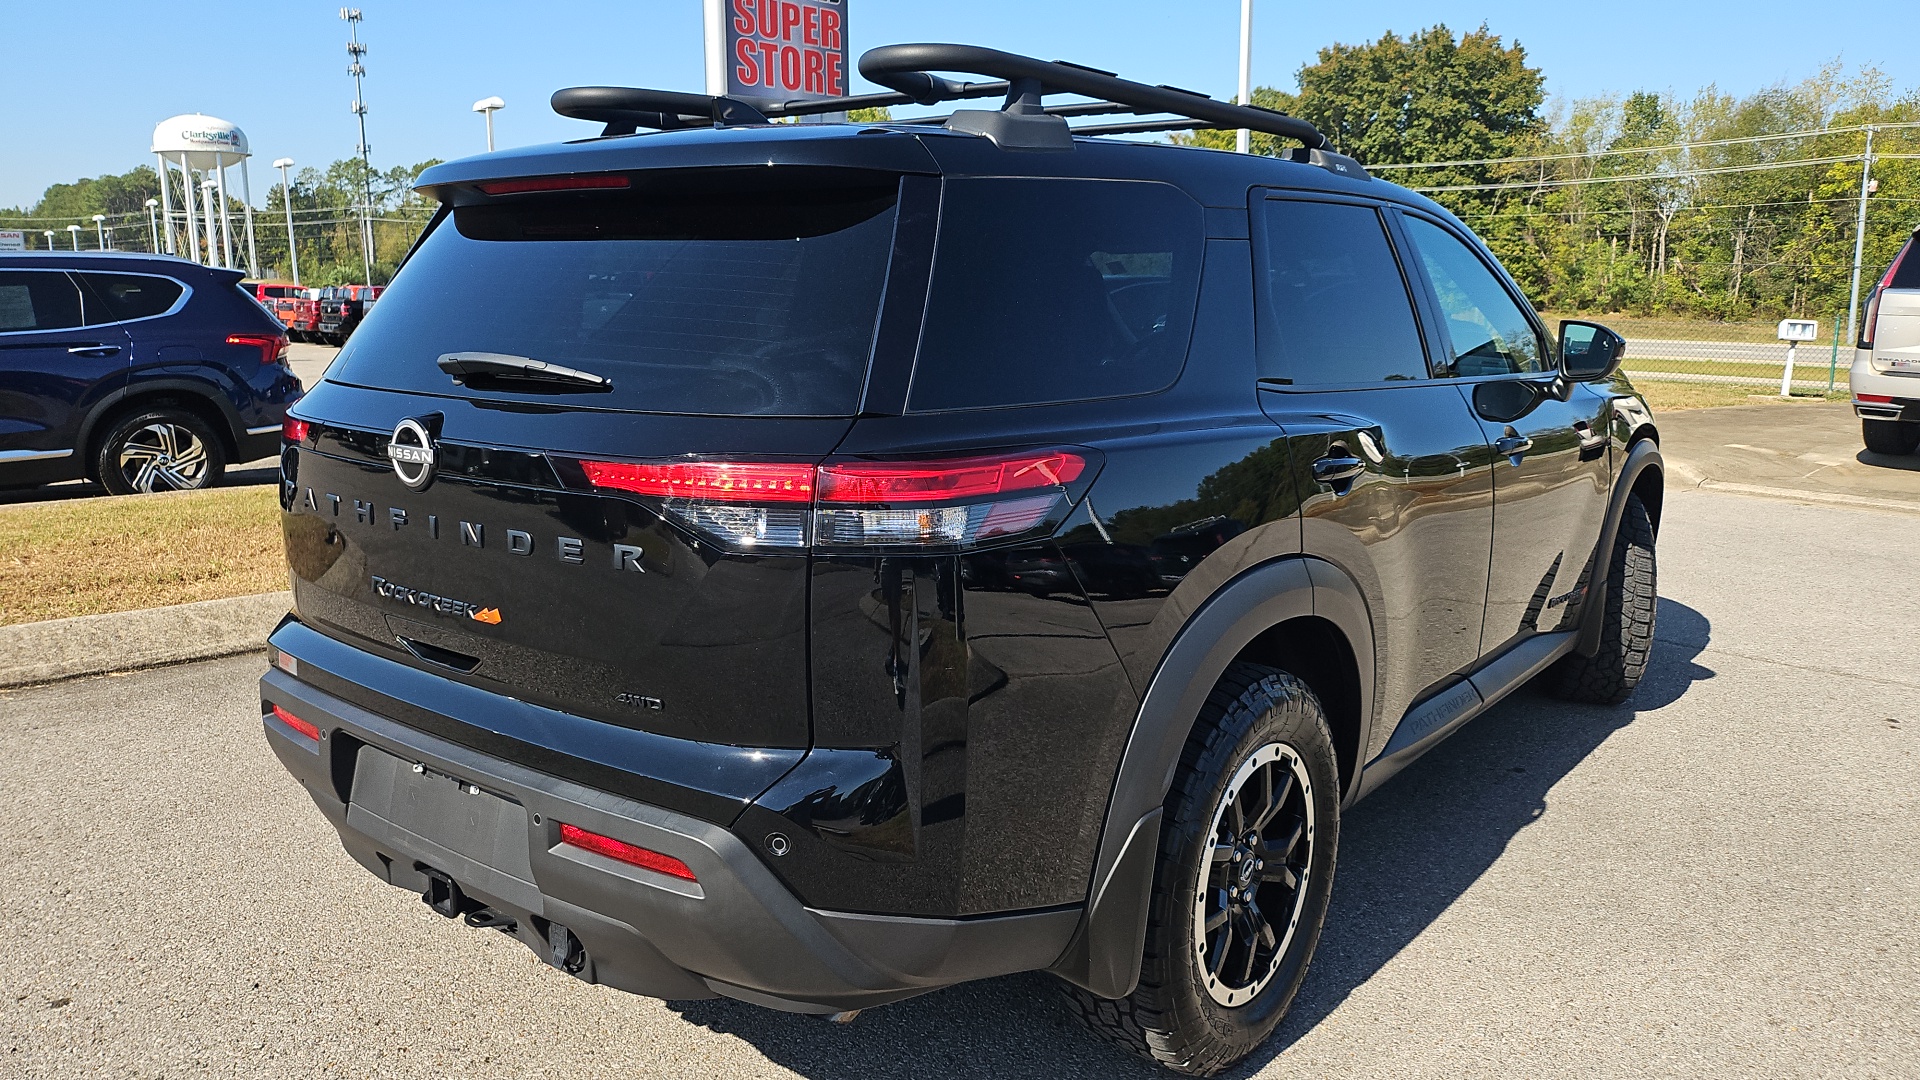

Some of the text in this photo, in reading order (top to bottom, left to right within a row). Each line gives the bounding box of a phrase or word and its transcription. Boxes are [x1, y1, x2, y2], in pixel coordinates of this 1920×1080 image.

[733, 0, 841, 50] SUPER
[736, 37, 842, 97] STORE
[182, 130, 231, 141] Clarksville
[388, 445, 432, 462] NISSAN
[284, 479, 646, 574] PATHFINDER
[371, 575, 479, 620] ROCK CREEK
[613, 692, 665, 711] 4WD
[1409, 687, 1478, 736] PATHFINDER
